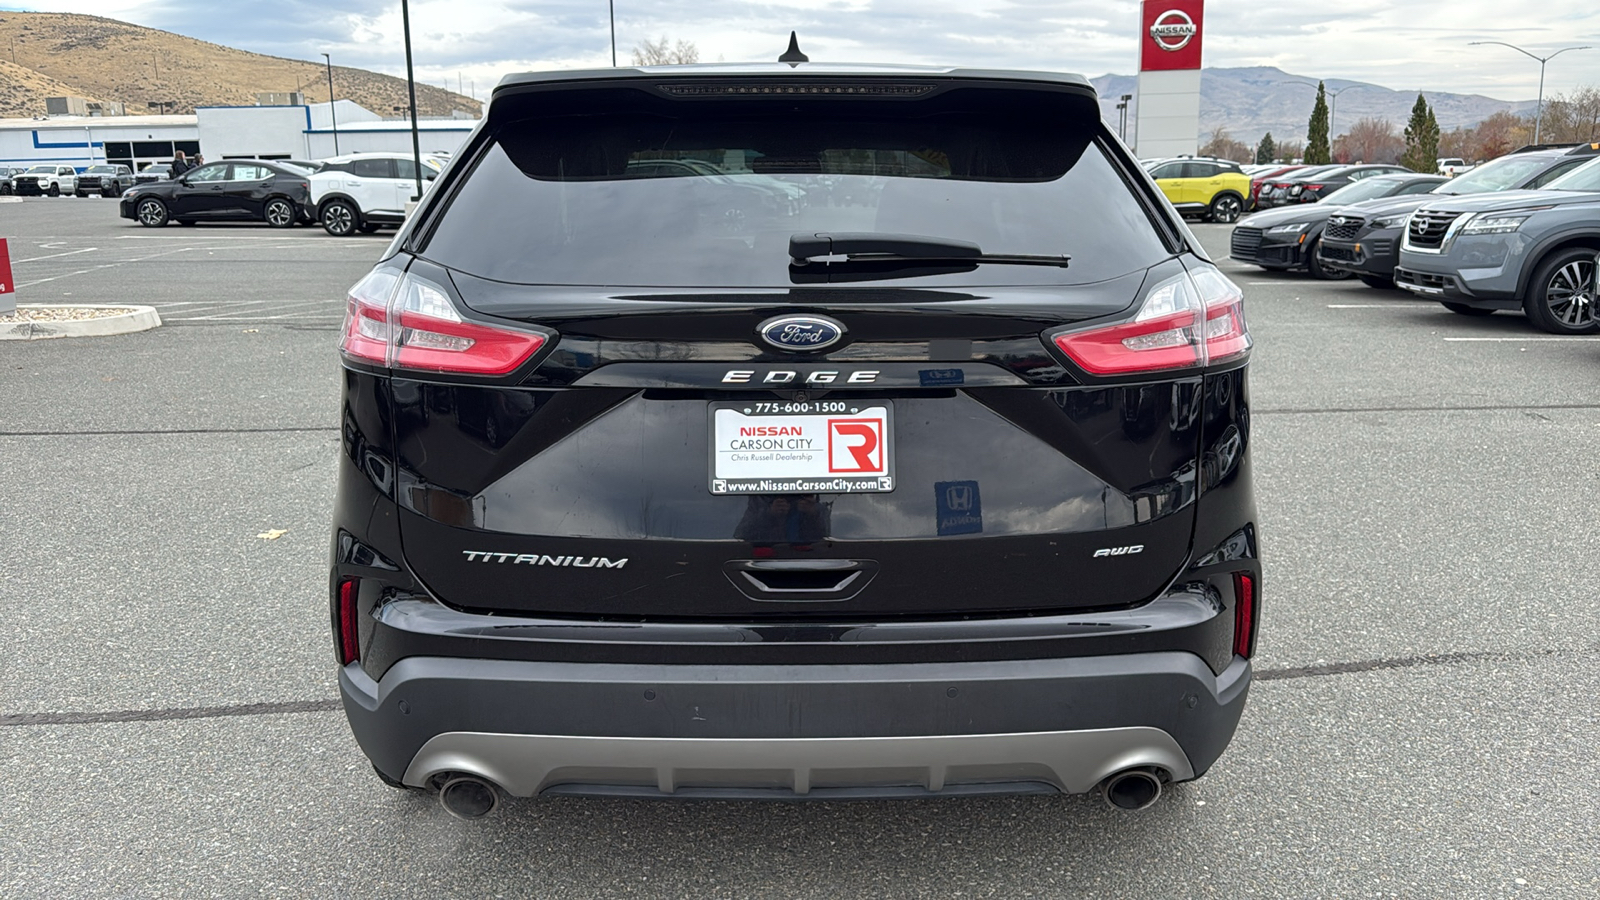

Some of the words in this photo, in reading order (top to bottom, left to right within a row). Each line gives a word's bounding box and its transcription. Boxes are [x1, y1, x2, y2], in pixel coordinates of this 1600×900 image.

[1155, 26, 1193, 34] NISSAN
[780, 324, 823, 343] Ford
[721, 370, 880, 384] EDGE
[755, 402, 846, 413] 775-600-1500
[740, 426, 802, 436] NISSAN
[730, 439, 783, 450] CARSON
[787, 438, 813, 449] CITY
[731, 453, 749, 461] Chris
[751, 453, 774, 461] Russell
[775, 452, 813, 462] Dealership
[728, 479, 877, 492] www.NissanCarsonCity.com
[1093, 545, 1145, 558] AWD
[462, 550, 629, 569] TITANIUM
